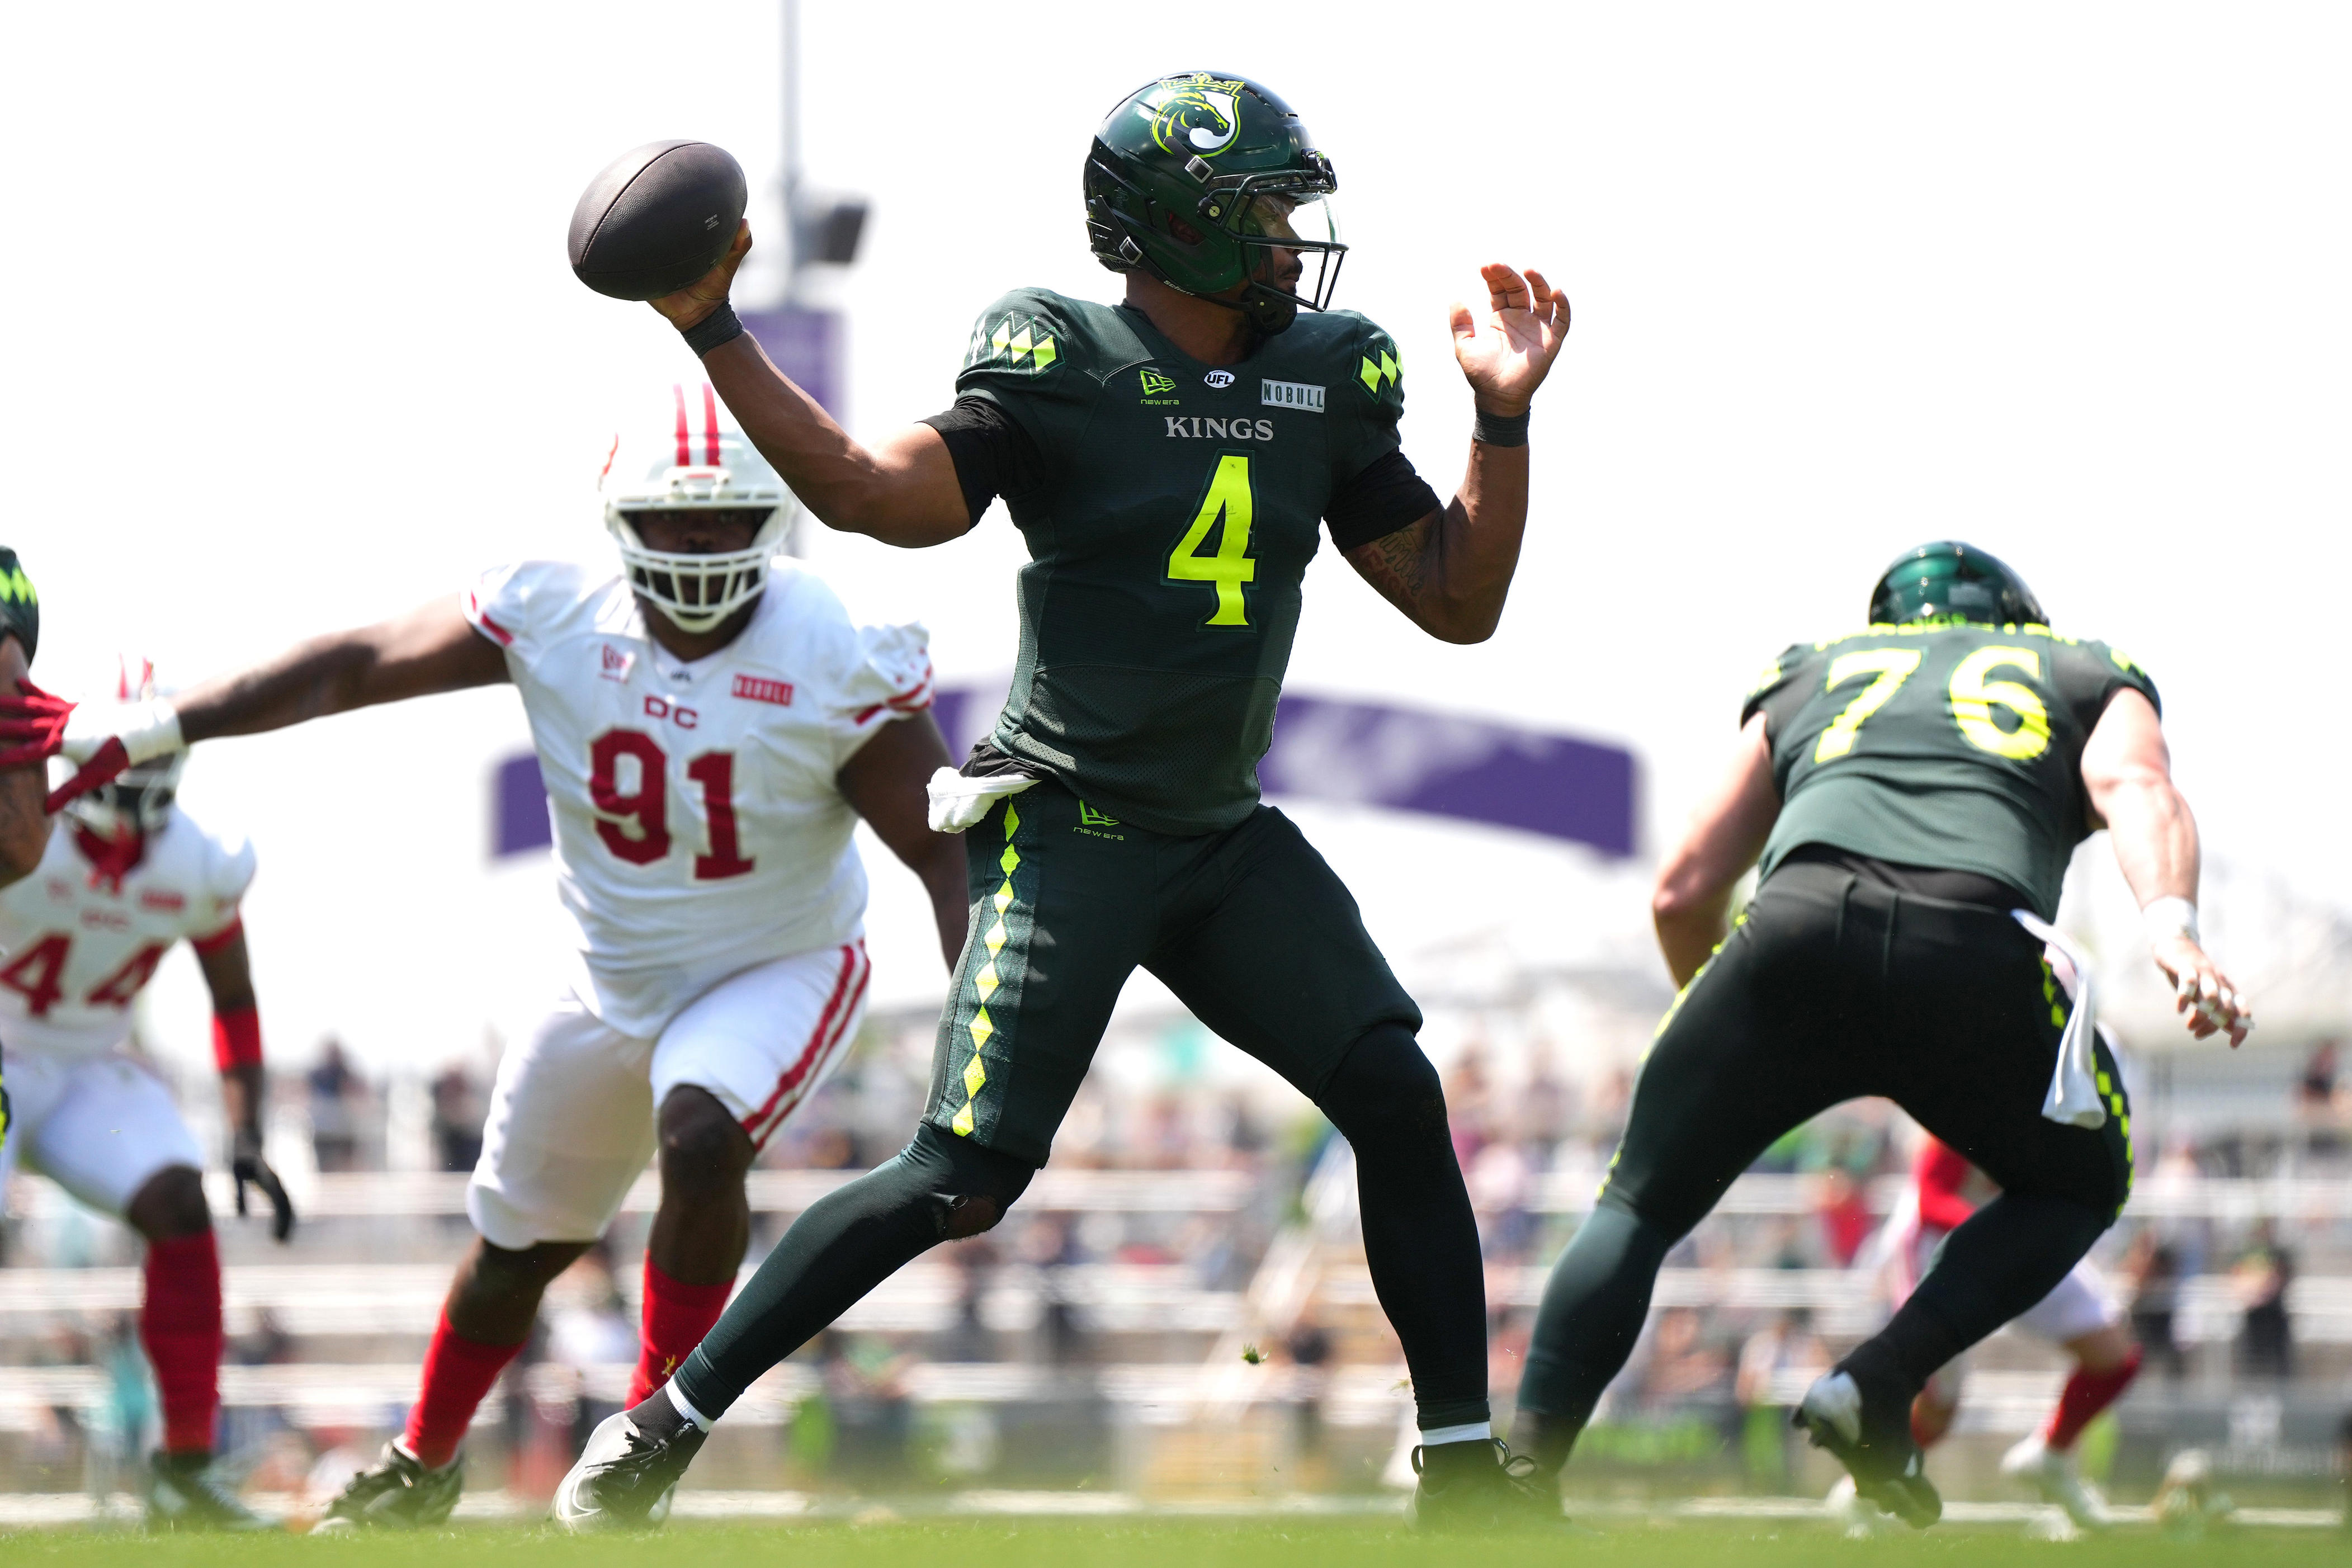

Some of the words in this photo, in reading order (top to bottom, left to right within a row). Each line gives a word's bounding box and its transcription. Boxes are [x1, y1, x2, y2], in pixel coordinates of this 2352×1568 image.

[1207, 374, 1231, 385] UFL
[1264, 384, 1324, 408] NOBULL
[1164, 417, 1274, 441] KINGS
[1168, 456, 1257, 625] 4
[645, 696, 698, 729] DC
[1815, 645, 2051, 763] 76
[589, 729, 755, 880] 91
[0, 934, 166, 1015] 44
